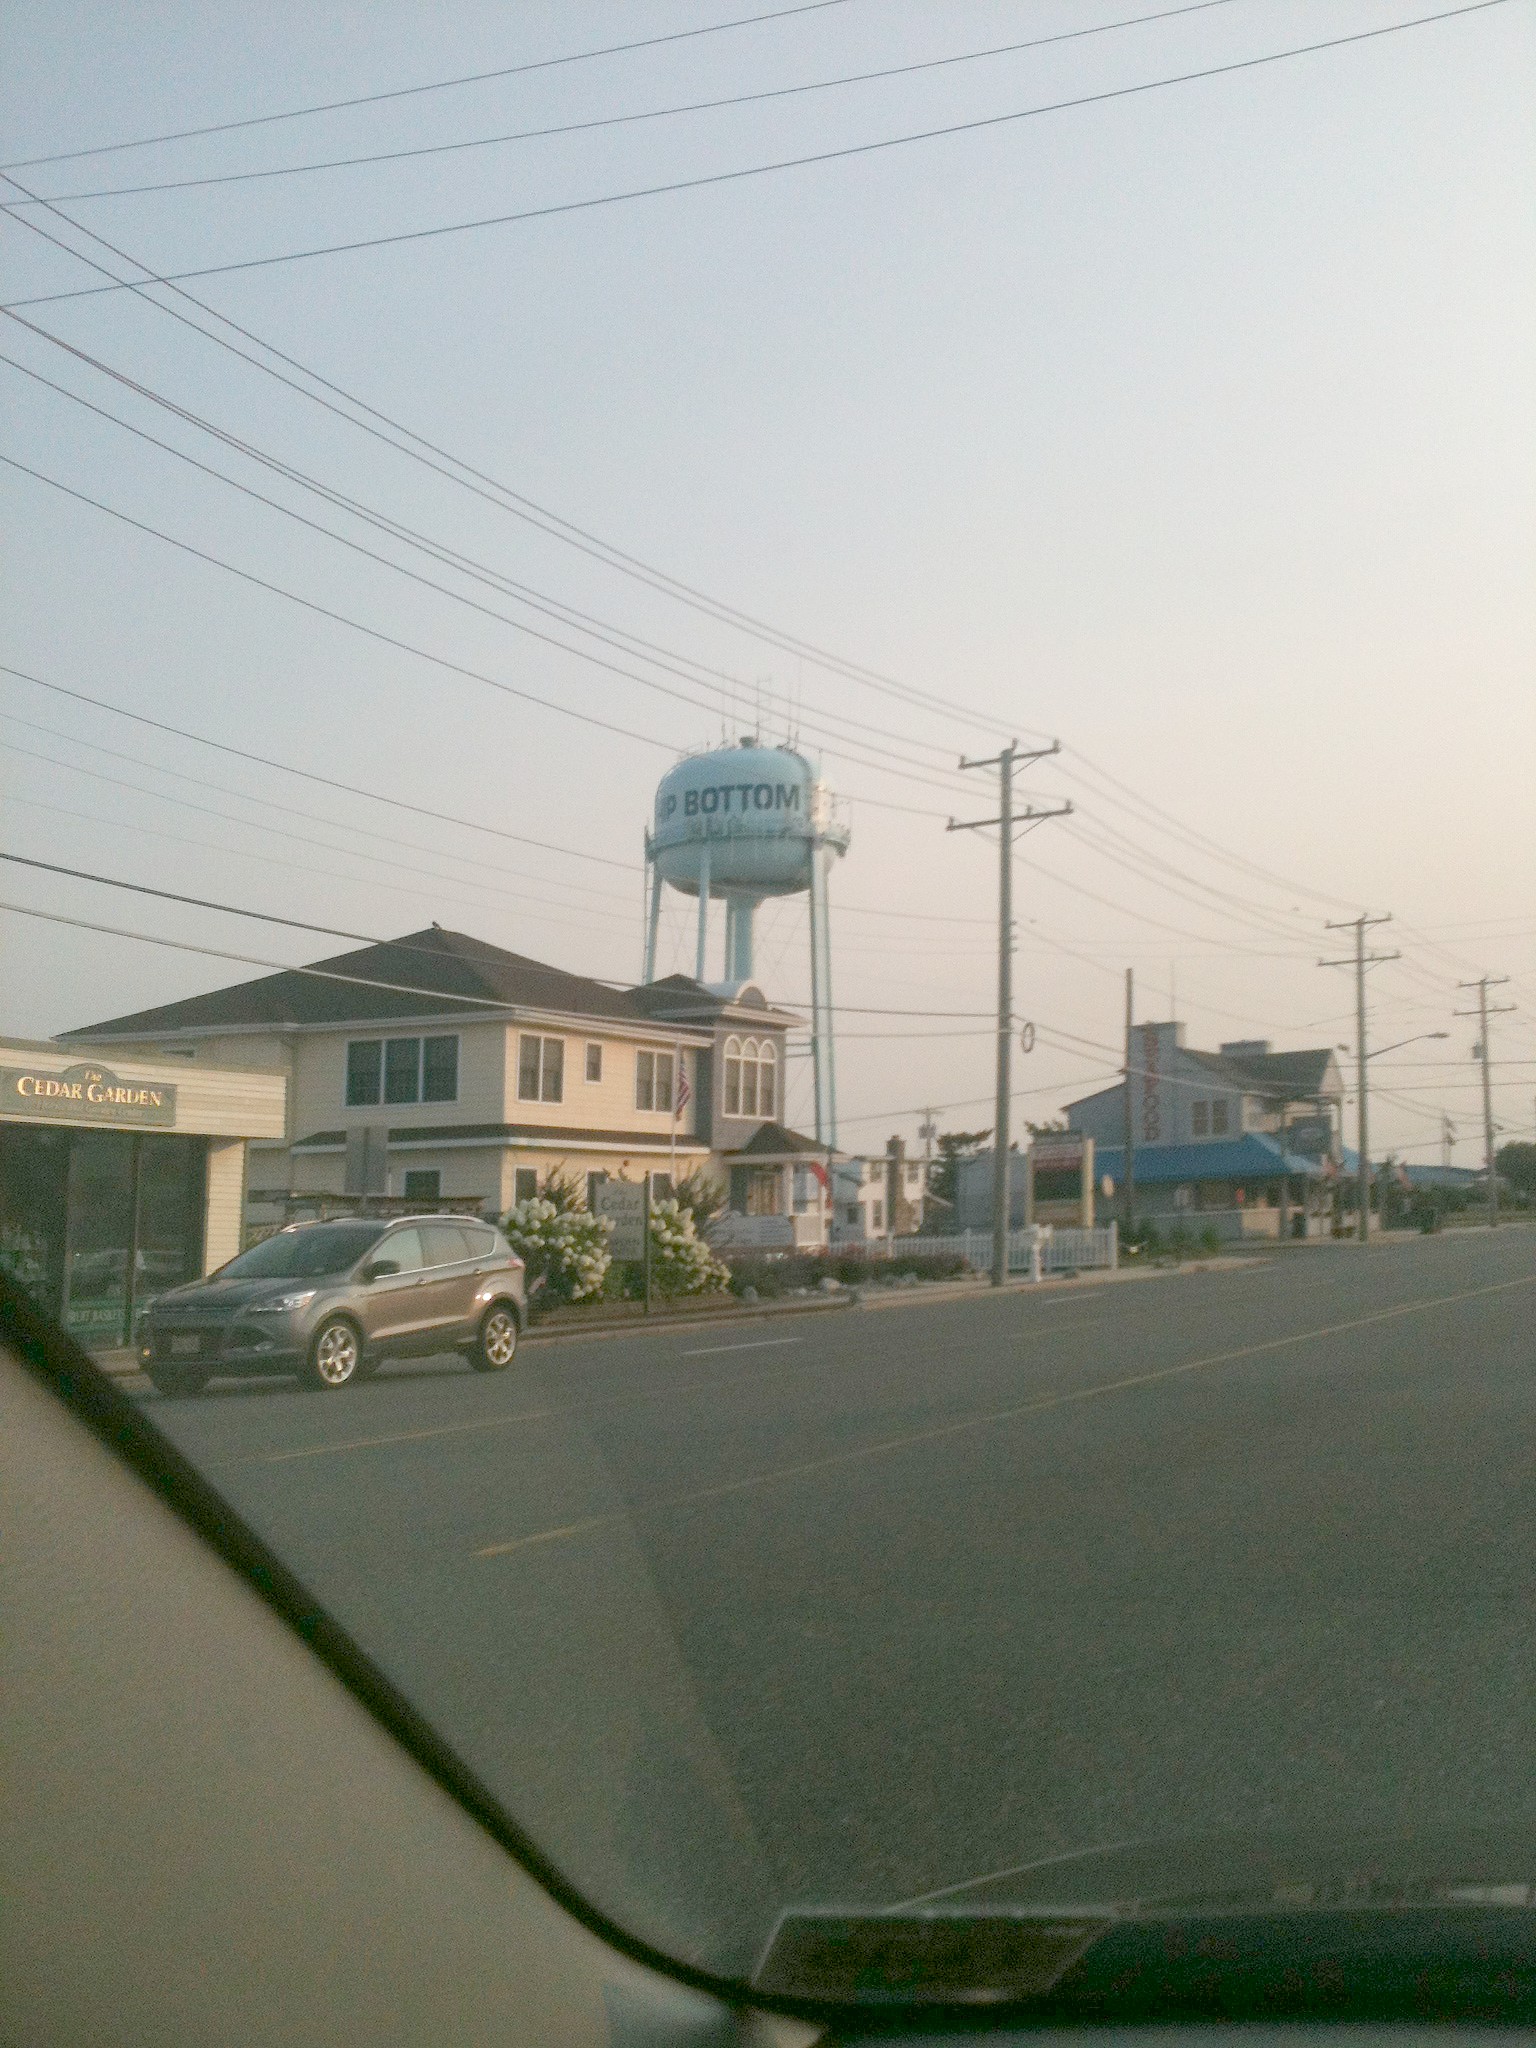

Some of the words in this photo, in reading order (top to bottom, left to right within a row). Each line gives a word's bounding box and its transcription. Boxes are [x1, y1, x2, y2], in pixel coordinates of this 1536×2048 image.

[683, 784, 800, 817] BOTTOM
[17, 1076, 82, 1099] CEDAR
[87, 1083, 162, 1107] GARDEN
